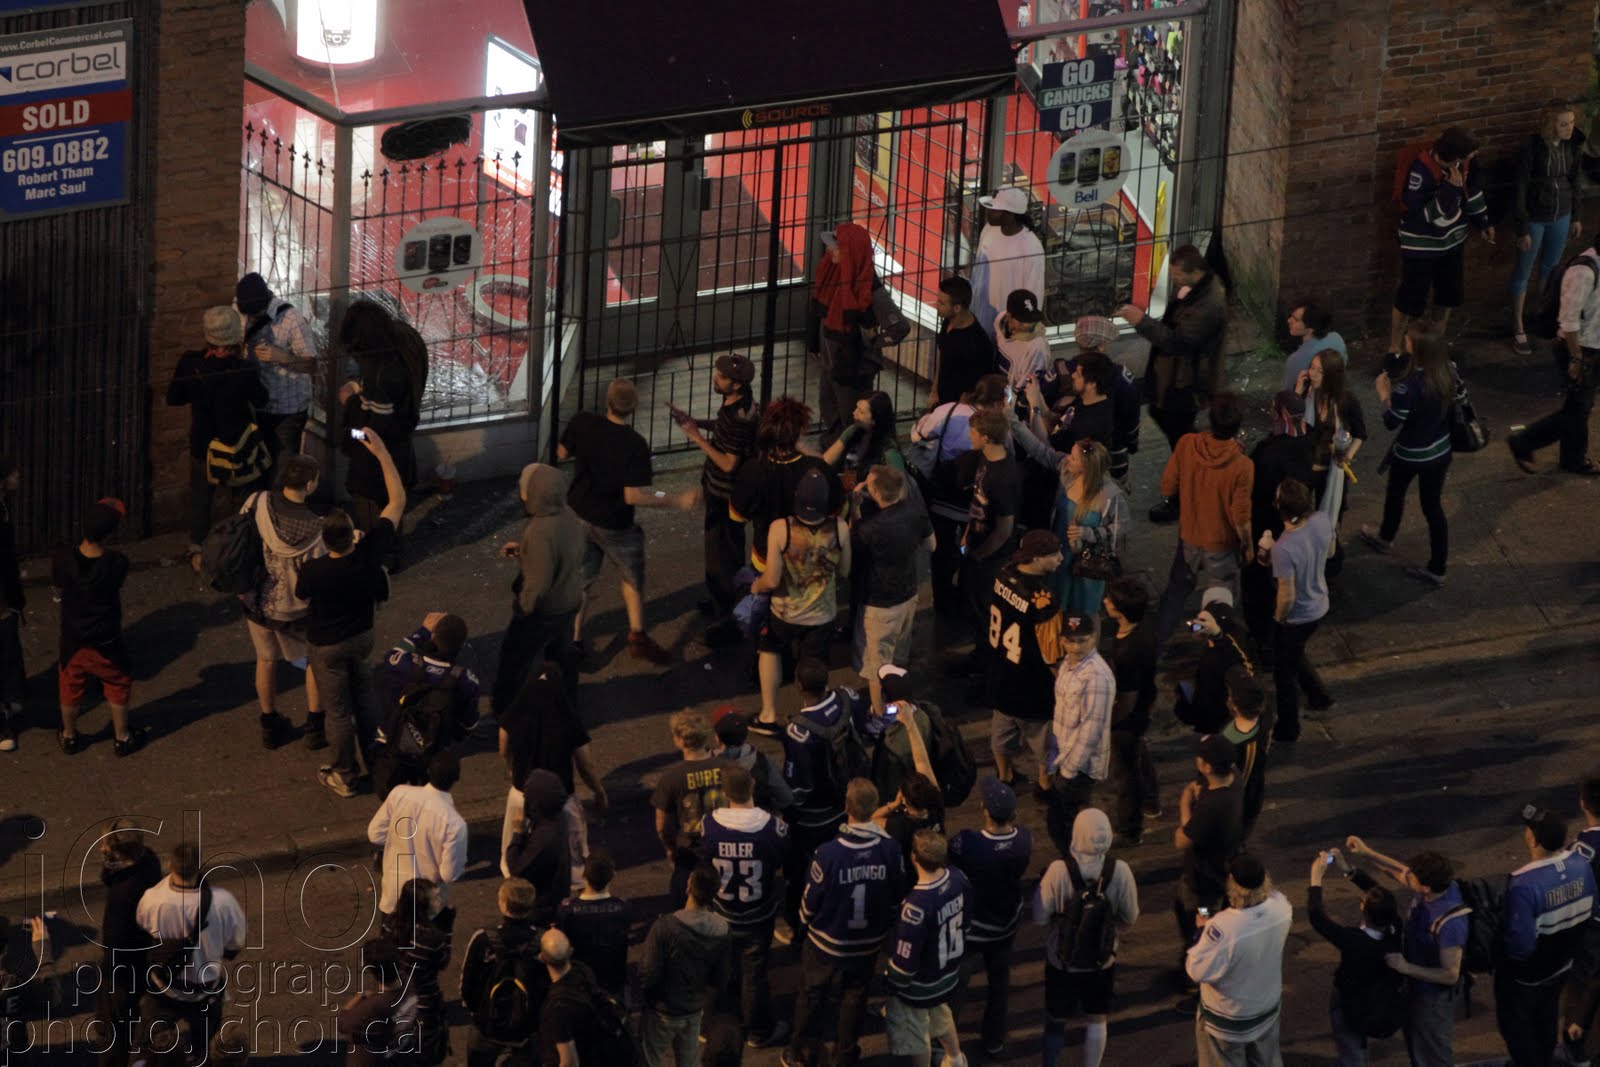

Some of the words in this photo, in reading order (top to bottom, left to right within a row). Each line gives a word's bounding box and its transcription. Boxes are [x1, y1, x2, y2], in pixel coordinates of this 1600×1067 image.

[16, 46, 121, 82] corbel
[1062, 59, 1095, 87] GO
[1044, 83, 1110, 107] CANUCKS
[22, 99, 90, 131] SOLD
[1059, 104, 1093, 131] GO
[3, 136, 109, 173] 609.0882
[18, 172, 58, 187] Robert
[61, 166, 94, 181] Tham
[25, 186, 56, 201] Marc
[59, 181, 86, 196] Saul
[1074, 189, 1098, 204] Bell
[989, 603, 1022, 665] 84
[686, 768, 721, 790] BURE
[718, 842, 754, 858] EDLER
[712, 857, 763, 903] 23
[838, 864, 887, 885] LUONGO
[847, 883, 869, 929] 1
[896, 939, 913, 960] 16
[938, 910, 965, 970] 16
